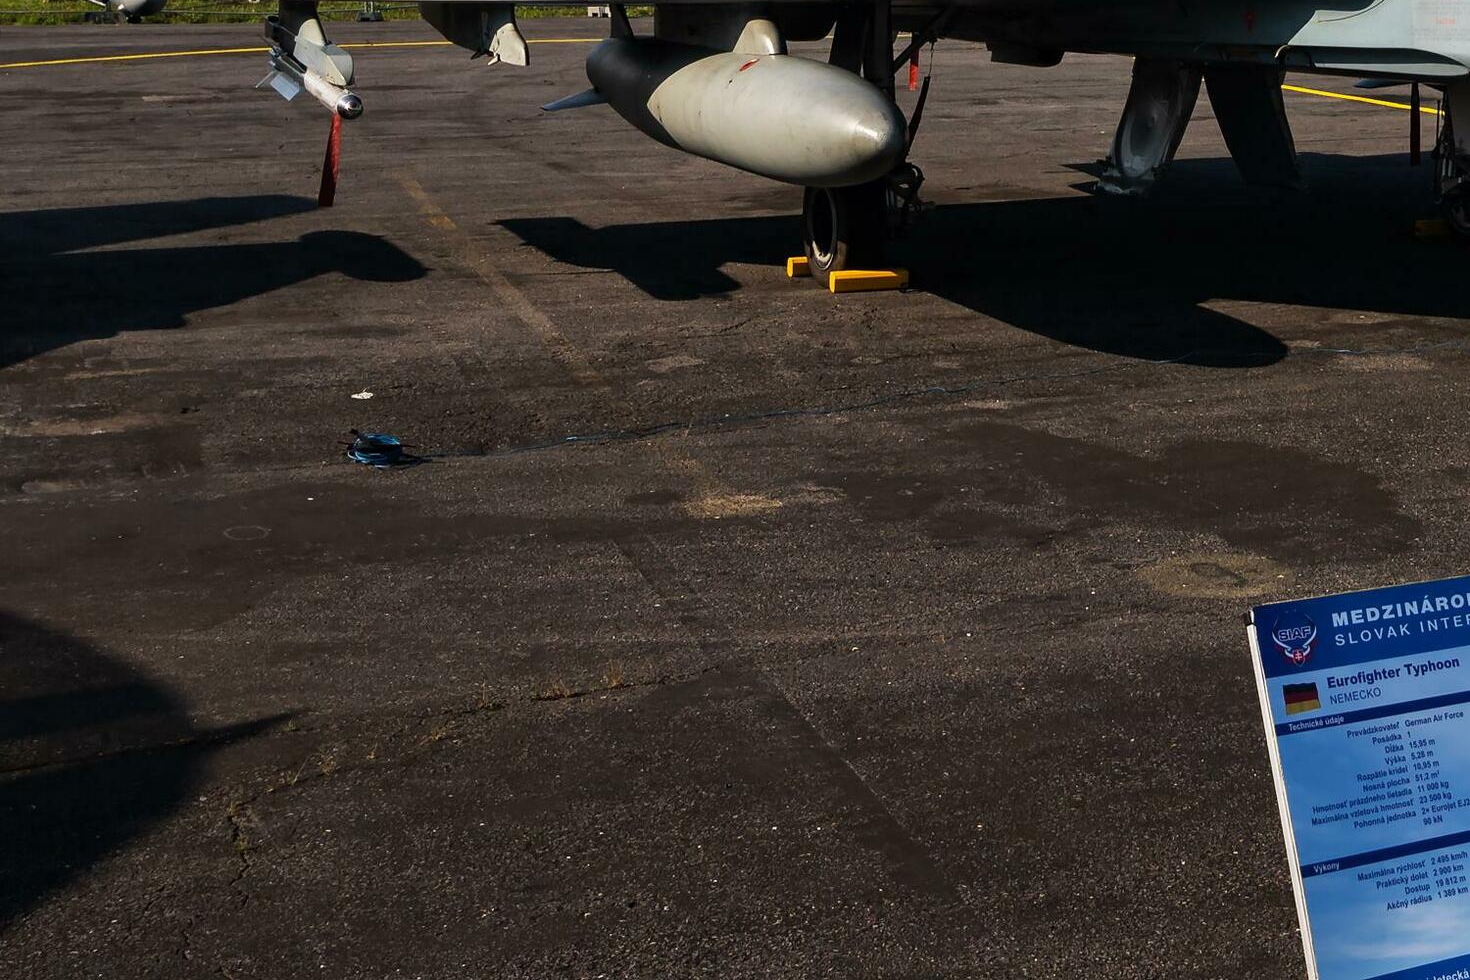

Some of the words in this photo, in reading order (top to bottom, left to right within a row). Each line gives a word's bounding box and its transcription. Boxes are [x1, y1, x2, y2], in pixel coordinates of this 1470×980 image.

[1278, 626, 1312, 641] SIAF
[1335, 624, 1411, 646] SLOVAK
[1327, 667, 1401, 689] Eurofighter
[1404, 658, 1460, 677] Typhoon
[1330, 687, 1382, 705] NEMECKO
[1405, 717, 1432, 727] German
[1433, 714, 1443, 722] Air
[1444, 711, 1464, 720] Force
[1440, 781, 1449, 789] kg
[1443, 792, 1452, 800] kg
[1432, 802, 1456, 812] Eurojet
[1452, 863, 1464, 872] km
[1405, 883, 1430, 895] Dostup
[1410, 894, 1433, 906] rádius
[1457, 886, 1469, 895] km
